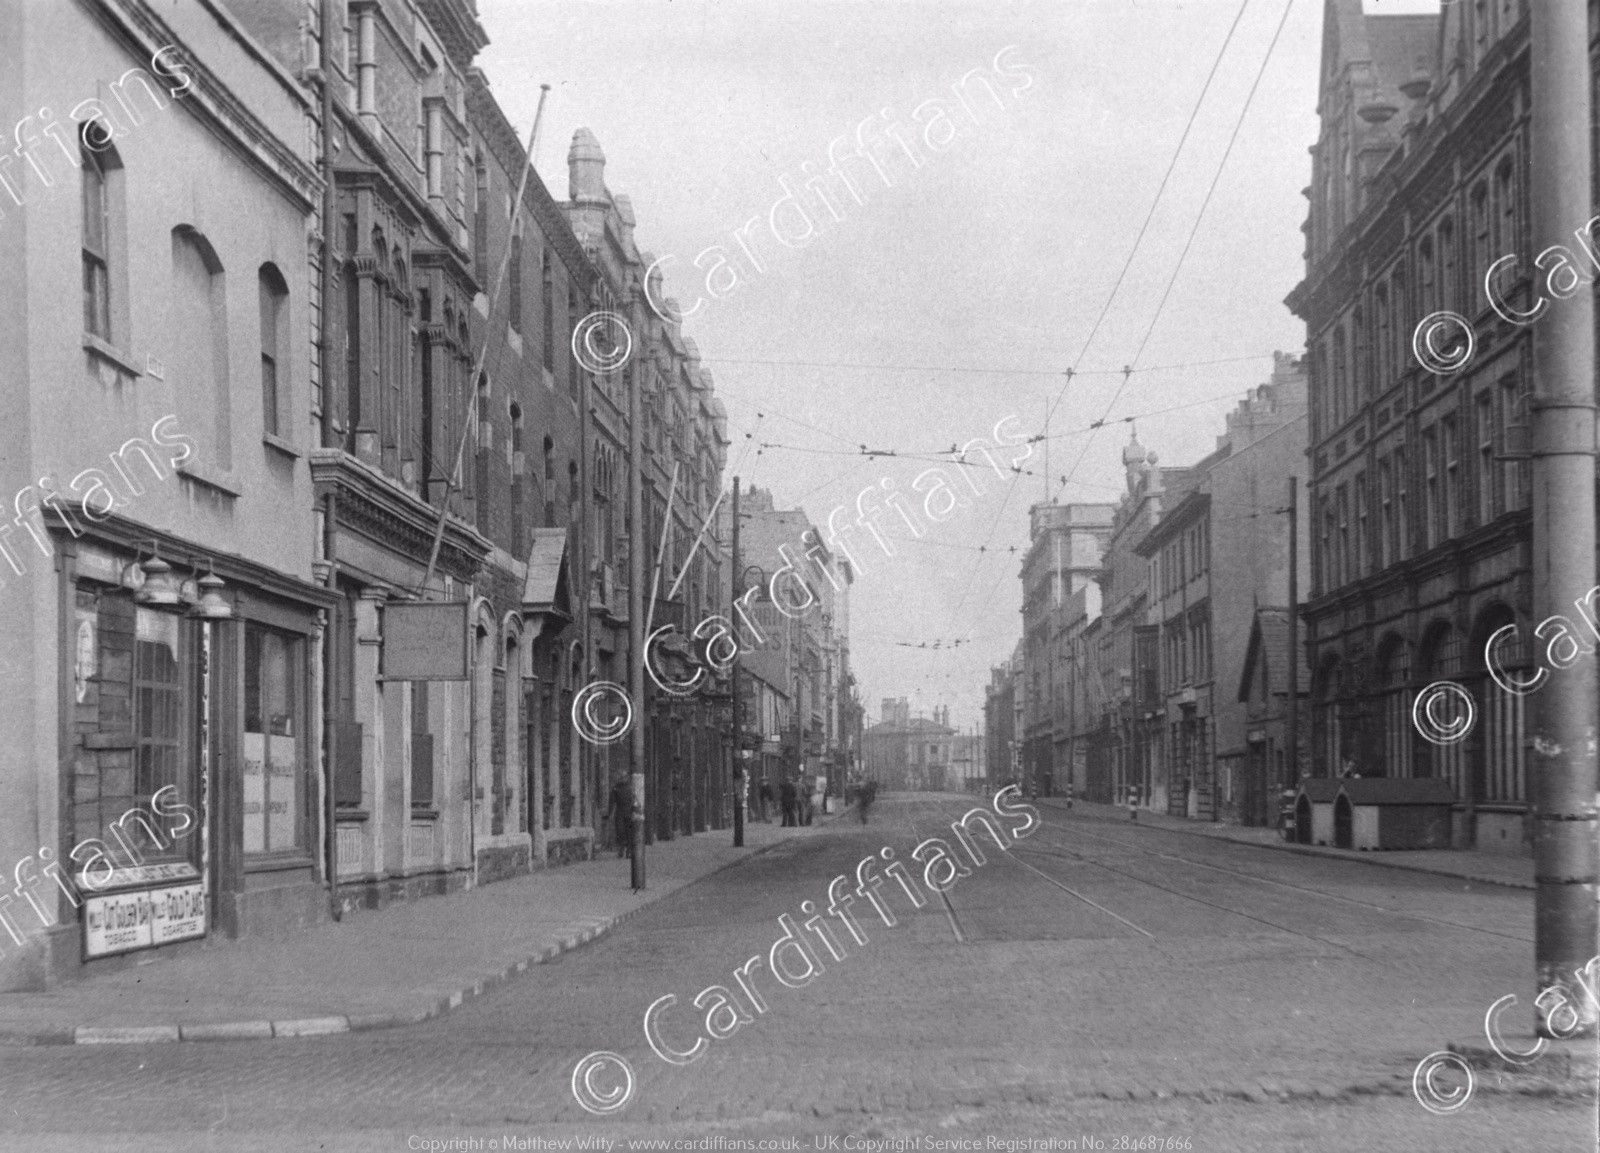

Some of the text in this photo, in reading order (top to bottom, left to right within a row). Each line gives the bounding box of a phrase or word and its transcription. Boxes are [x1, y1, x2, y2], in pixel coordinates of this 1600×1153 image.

[166, 892, 184, 921] GOLD
[163, 920, 197, 937] CIGARETTES
[104, 930, 137, 946] TOBACCO
